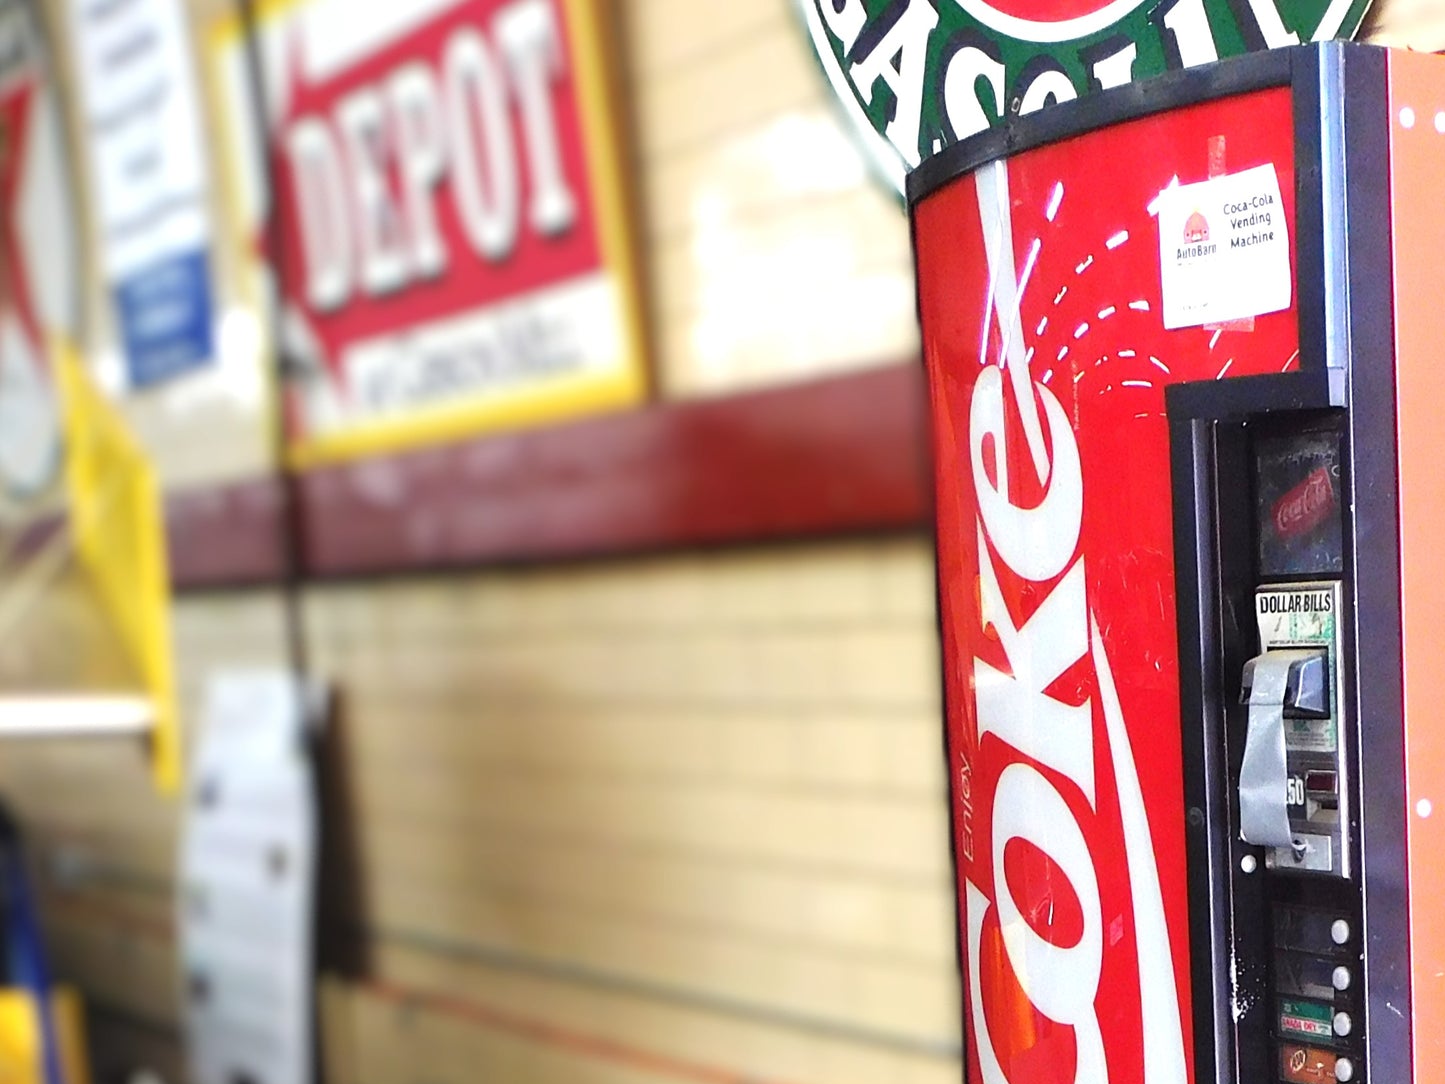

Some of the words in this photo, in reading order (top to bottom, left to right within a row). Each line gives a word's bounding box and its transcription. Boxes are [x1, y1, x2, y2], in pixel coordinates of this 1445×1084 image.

[284, 0, 575, 313] DEPOT
[1223, 194, 1274, 215] Coca-Cola
[1230, 212, 1272, 230] Vending
[1230, 231, 1274, 249] Machine
[1176, 244, 1217, 260] AutoBarn
[1260, 594, 1302, 614] DOLLAR
[1303, 593, 1331, 612] BILLS
[959, 751, 974, 863] Enjoy
